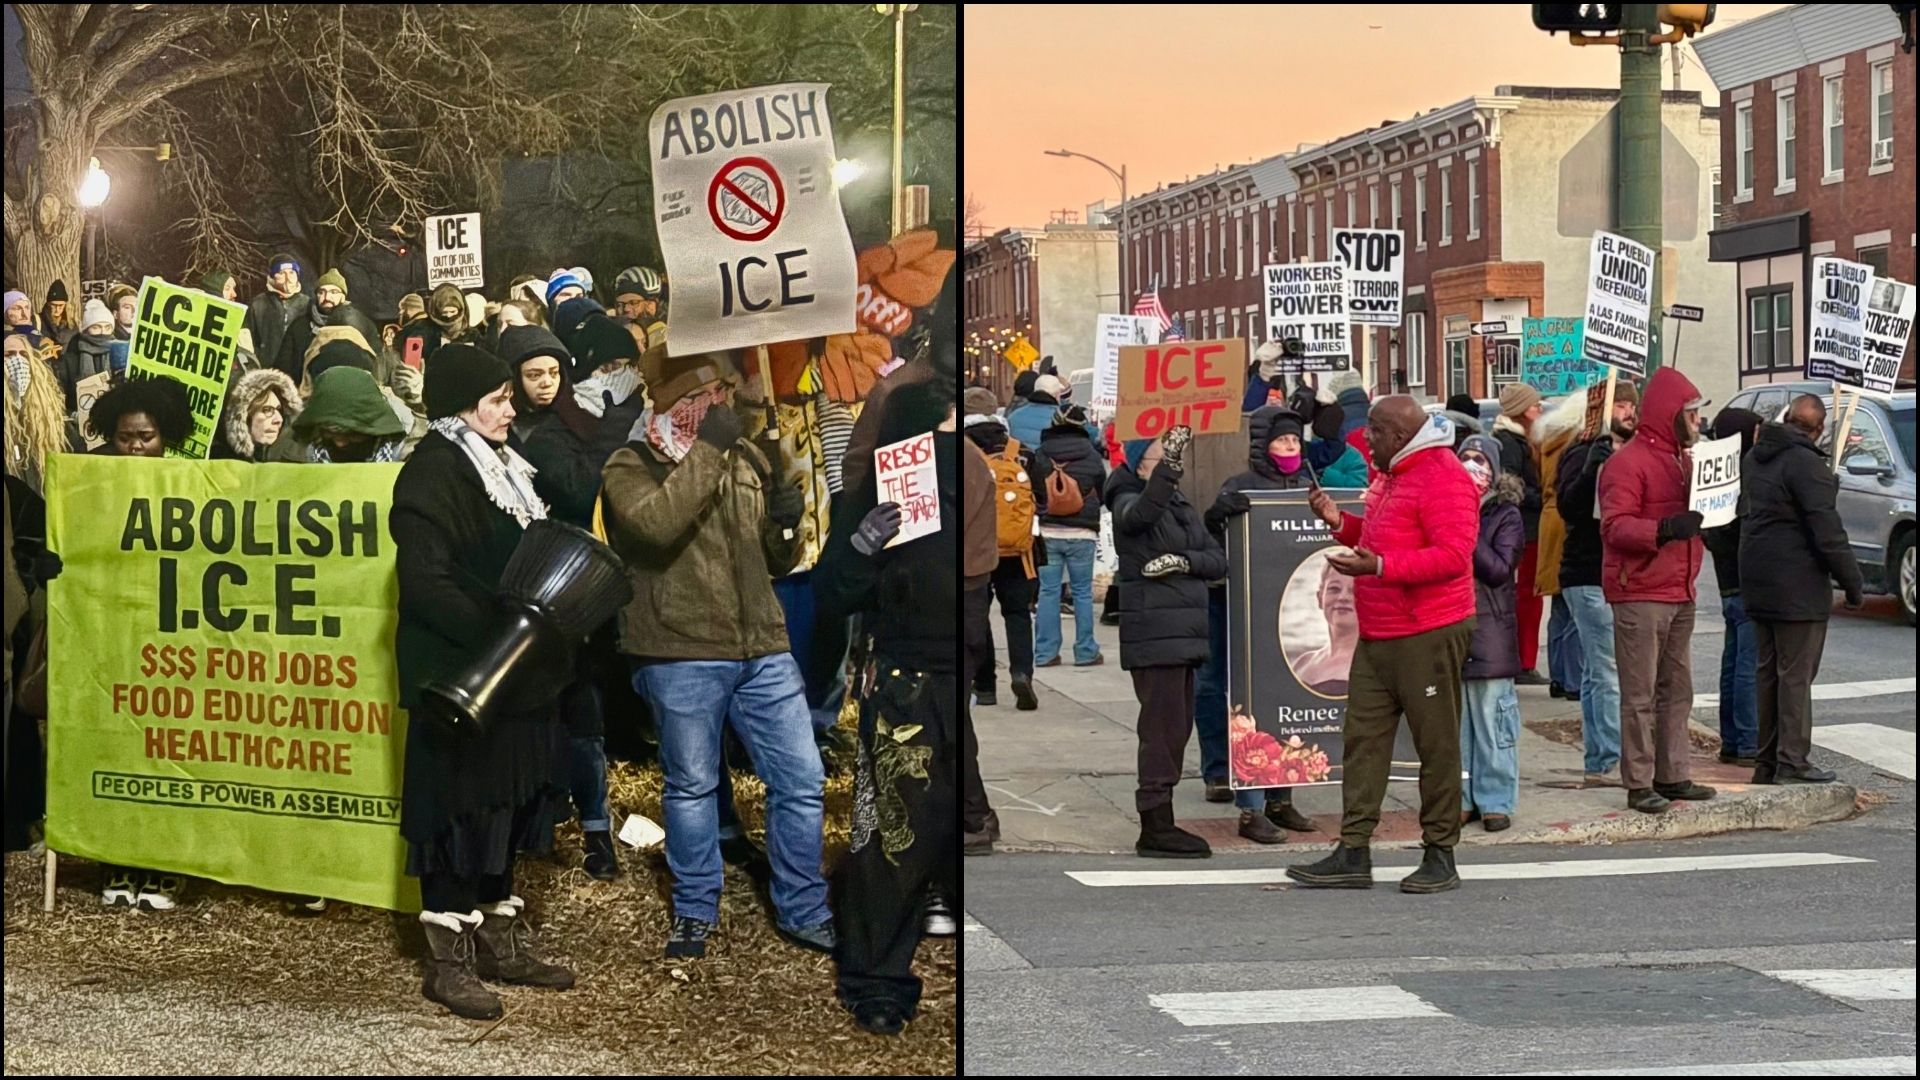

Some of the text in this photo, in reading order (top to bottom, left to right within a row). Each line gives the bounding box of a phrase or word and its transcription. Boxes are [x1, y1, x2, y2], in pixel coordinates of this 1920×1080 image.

[660, 91, 822, 159] ABOLISH
[437, 217, 468, 250] ICE
[433, 253, 475, 267] OUT OF OUR
[1334, 231, 1401, 272] STOP
[1597, 236, 1651, 267] ¡EL PUEBLO
[430, 265, 481, 280] COMMUNITIES
[719, 248, 816, 317] ICE
[1268, 266, 1342, 283] WORKERS
[1601, 254, 1647, 289] UNIDO
[1820, 262, 1866, 283] ¡EL UEBLO
[1269, 283, 1311, 296] SHOULD
[1314, 282, 1343, 293] HAVE
[1353, 280, 1399, 298] TERROR
[141, 285, 232, 349] I.C.E.
[1270, 294, 1343, 317] POWER
[1350, 299, 1398, 312] OW!
[1589, 303, 1595, 315] A
[1596, 305, 1613, 320] LAS
[1272, 323, 1345, 340] NOT THE
[1814, 327, 1822, 337] A
[1865, 311, 1910, 339] STICE FOR
[134, 325, 229, 384] FUERA DE
[1303, 341, 1346, 352] NAIRES!
[1527, 342, 1556, 358] ARE
[1562, 338, 1574, 355] A
[1863, 337, 1903, 358] ENEE
[1144, 344, 1226, 393] ICE
[1872, 357, 1898, 379] GOOD
[1527, 374, 1558, 392] ARE
[1565, 374, 1577, 391] A
[1135, 400, 1227, 438] OUT
[877, 436, 933, 474] RESIST
[1697, 456, 1723, 486] ICE
[882, 471, 920, 502] THE
[1695, 497, 1706, 511] OF
[120, 498, 379, 558] ABOLISH
[1271, 519, 1331, 531] KILLE
[1296, 534, 1334, 543] JANUAR
[158, 558, 341, 637] I.C.E.
[141, 643, 358, 689] $$$ FOR JOBS
[112, 684, 390, 736] FOOD EDUCATION
[1279, 706, 1339, 723] Renee
[1281, 725, 1312, 735] Beloved
[144, 727, 352, 776] HEALTHCARE
[101, 776, 400, 820] PEOPLES POWER ASSEMBLY
